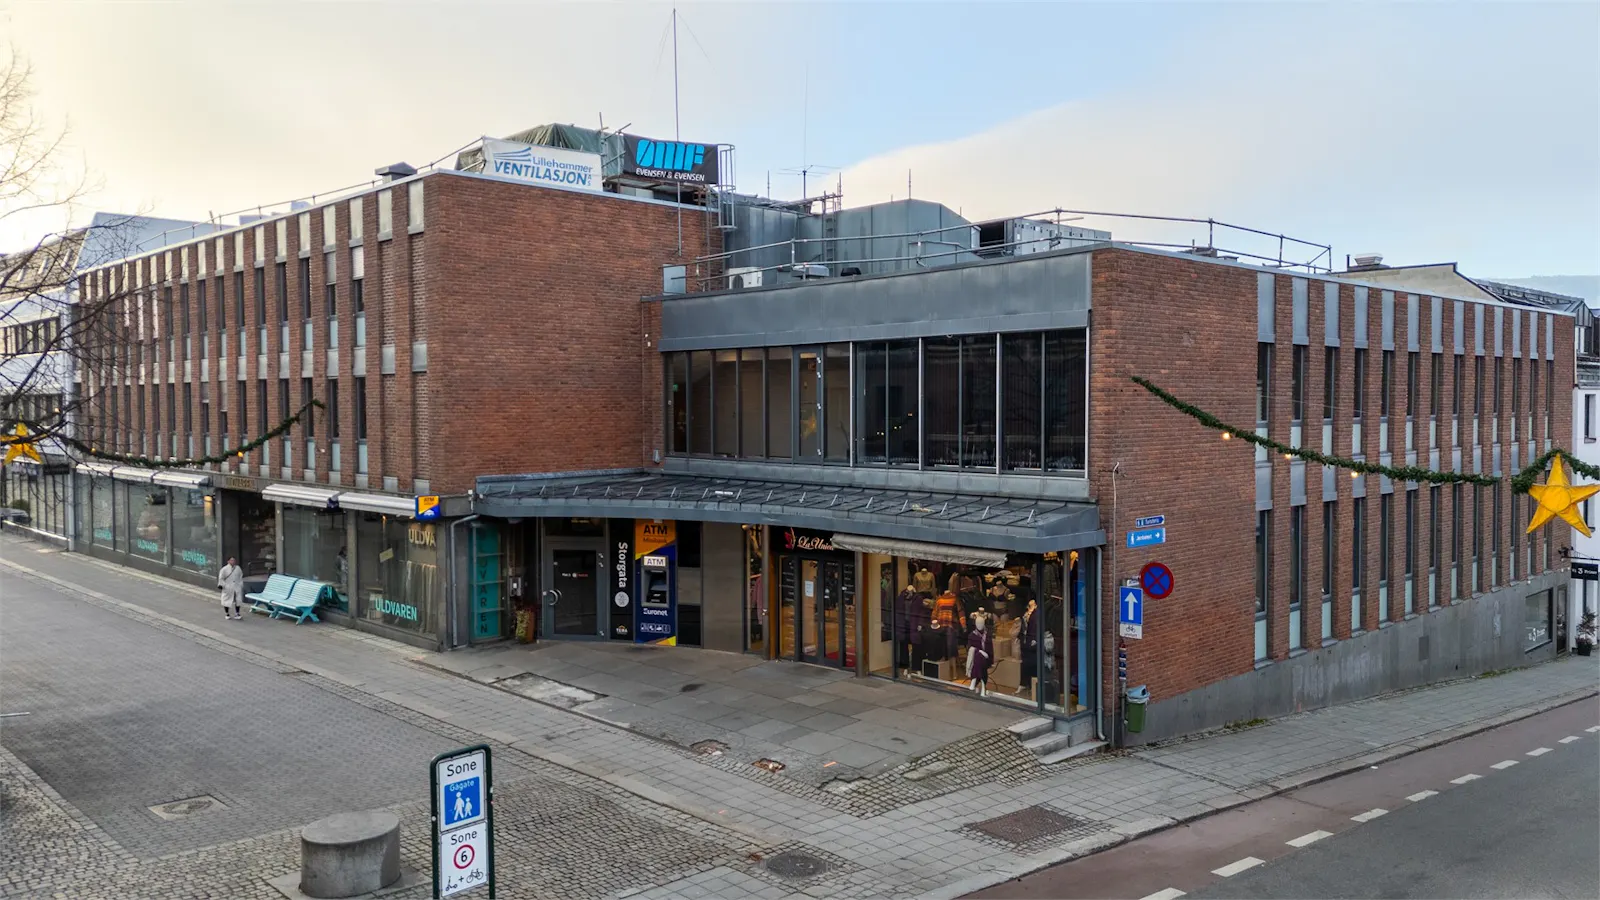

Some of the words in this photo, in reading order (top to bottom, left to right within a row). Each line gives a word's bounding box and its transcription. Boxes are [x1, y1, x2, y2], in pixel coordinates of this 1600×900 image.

[533, 156, 593, 173] Lillehammer
[494, 160, 588, 186] VENTILASJON
[636, 168, 666, 178] EVENSEN
[667, 171, 673, 179] &
[674, 172, 705, 182] EVENSEN
[644, 524, 668, 535] ATM
[797, 535, 813, 550] La
[616, 541, 628, 588] Storgata
[647, 558, 664, 566] ATM
[1577, 567, 1583, 575] 3
[375, 598, 418, 621] ULDVAREN
[643, 607, 668, 616] Euronet
[446, 760, 477, 777] Sone
[449, 779, 475, 792] Gågate
[450, 829, 478, 846] Sone
[460, 850, 468, 863] 6
